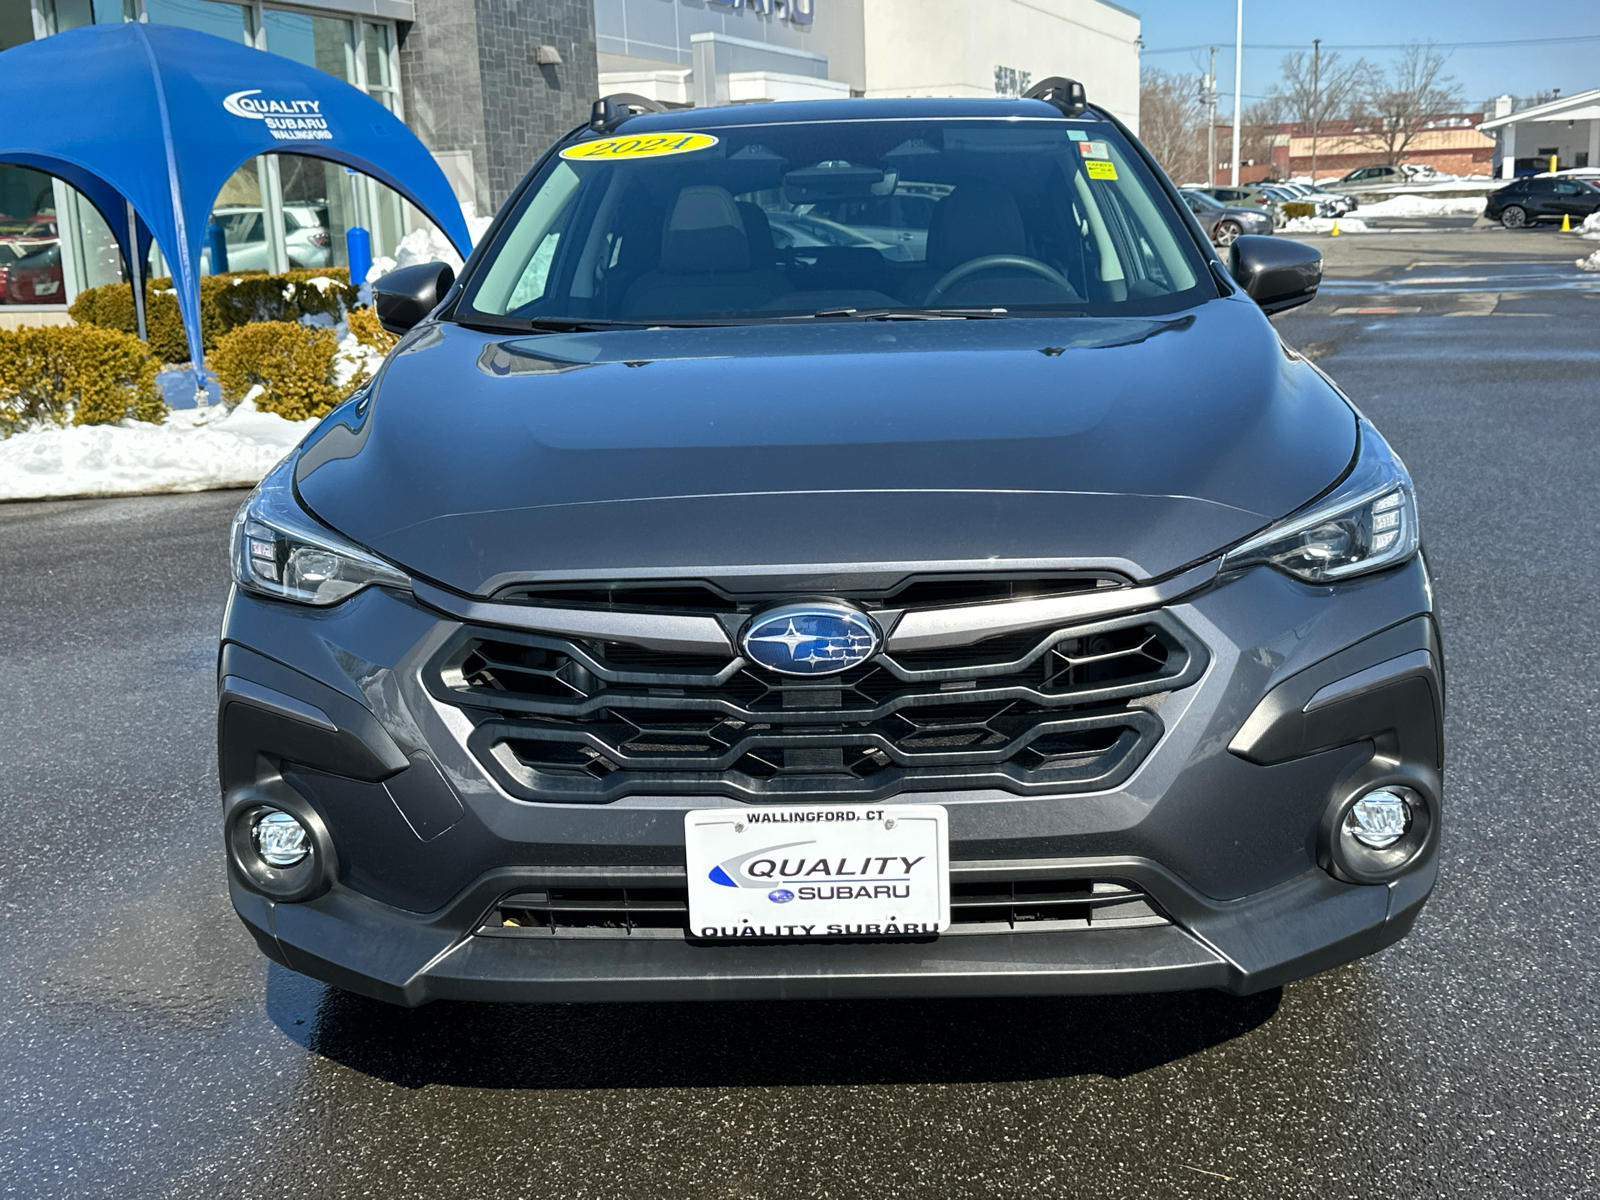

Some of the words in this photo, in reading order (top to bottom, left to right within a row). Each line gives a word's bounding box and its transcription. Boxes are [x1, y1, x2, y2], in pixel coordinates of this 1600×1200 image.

[240, 99, 319, 113] QUALITY
[265, 118, 327, 129] SUBARU
[269, 130, 333, 139] WALLINGFORD
[583, 136, 693, 157] 2024
[747, 811, 860, 823] WALLINGFORD,
[866, 810, 884, 821] CT
[747, 856, 926, 878] QUALITY
[797, 885, 911, 900] SUBARU
[701, 924, 817, 938] QUALITY
[827, 923, 940, 935] SUBARU
